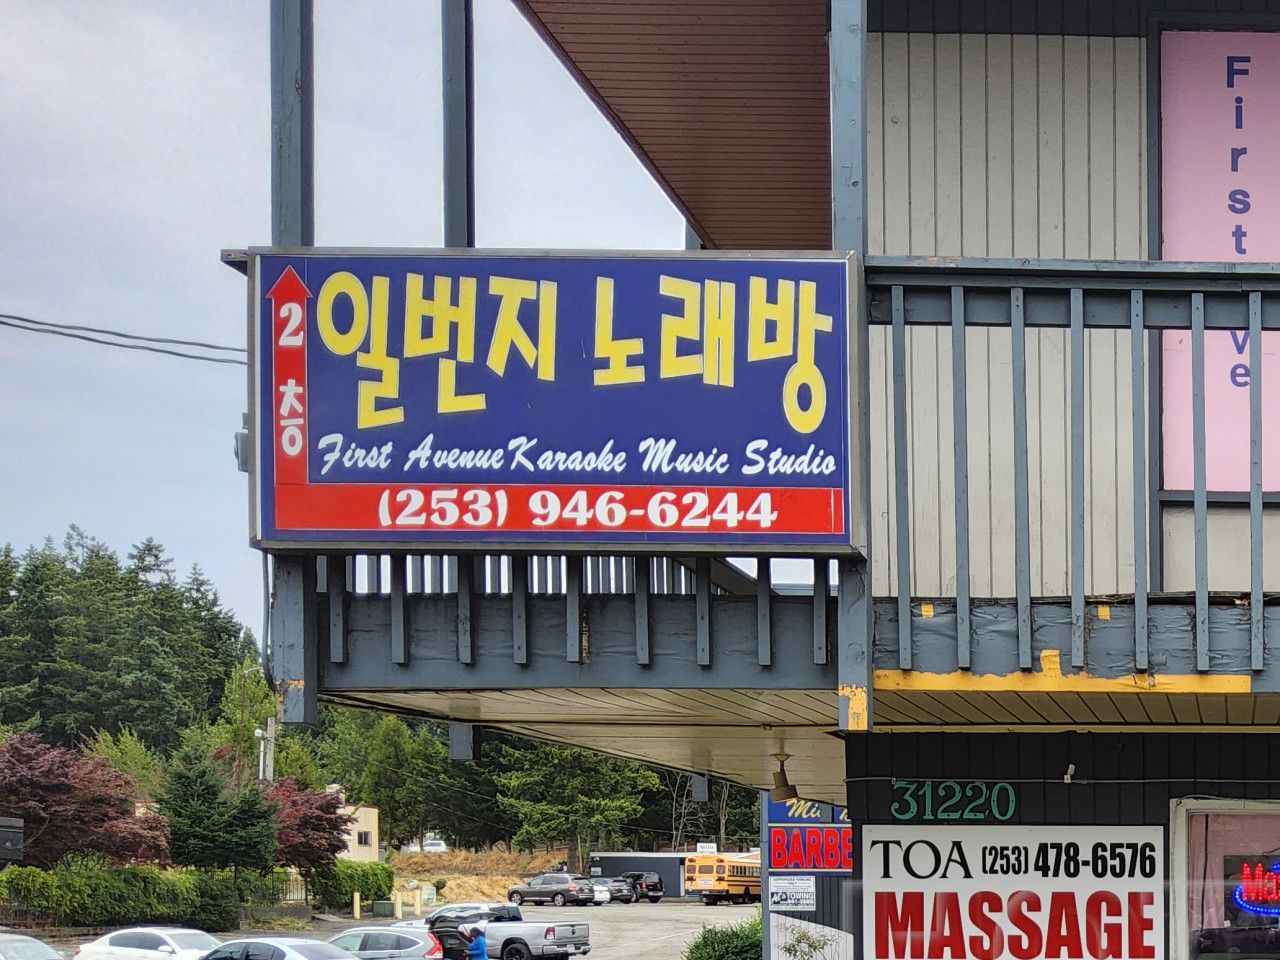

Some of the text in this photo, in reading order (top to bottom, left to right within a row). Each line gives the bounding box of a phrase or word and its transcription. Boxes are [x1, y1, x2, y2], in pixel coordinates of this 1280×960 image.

[1226, 56, 1251, 255] First
[316, 271, 832, 433] 일번지 노래방
[317, 433, 836, 475] First Avenue Karaoke Music Studio
[378, 489, 778, 528] (253) 946-6244
[890, 780, 1016, 820] 31220
[869, 840, 1156, 879] TOA (253) 478-6576
[787, 892, 814, 900] TOWING
[874, 889, 1156, 960] MASSAGE
